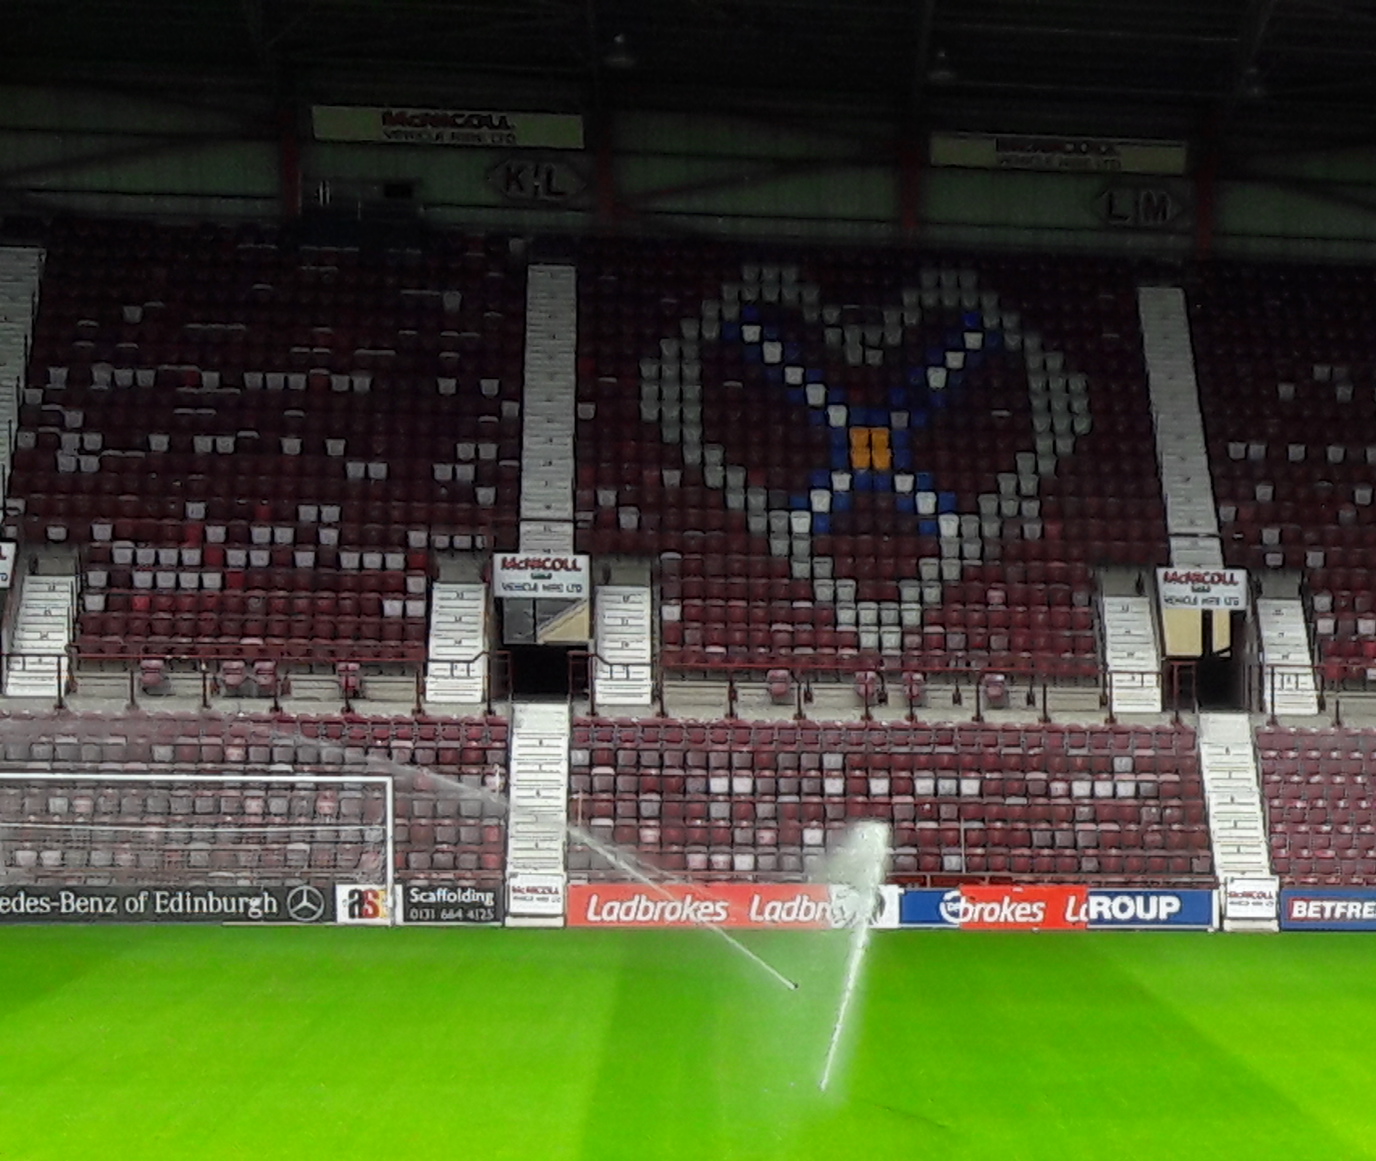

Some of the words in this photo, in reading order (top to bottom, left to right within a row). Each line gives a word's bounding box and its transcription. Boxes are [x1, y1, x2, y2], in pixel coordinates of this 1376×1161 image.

[124, 890, 150, 914] of
[154, 890, 278, 919] Edinburgh
[409, 887, 495, 906] Scaffolding
[586, 894, 730, 922] Ladbrokes
[1088, 895, 1181, 921] ROUP
[409, 907, 436, 920] 0131
